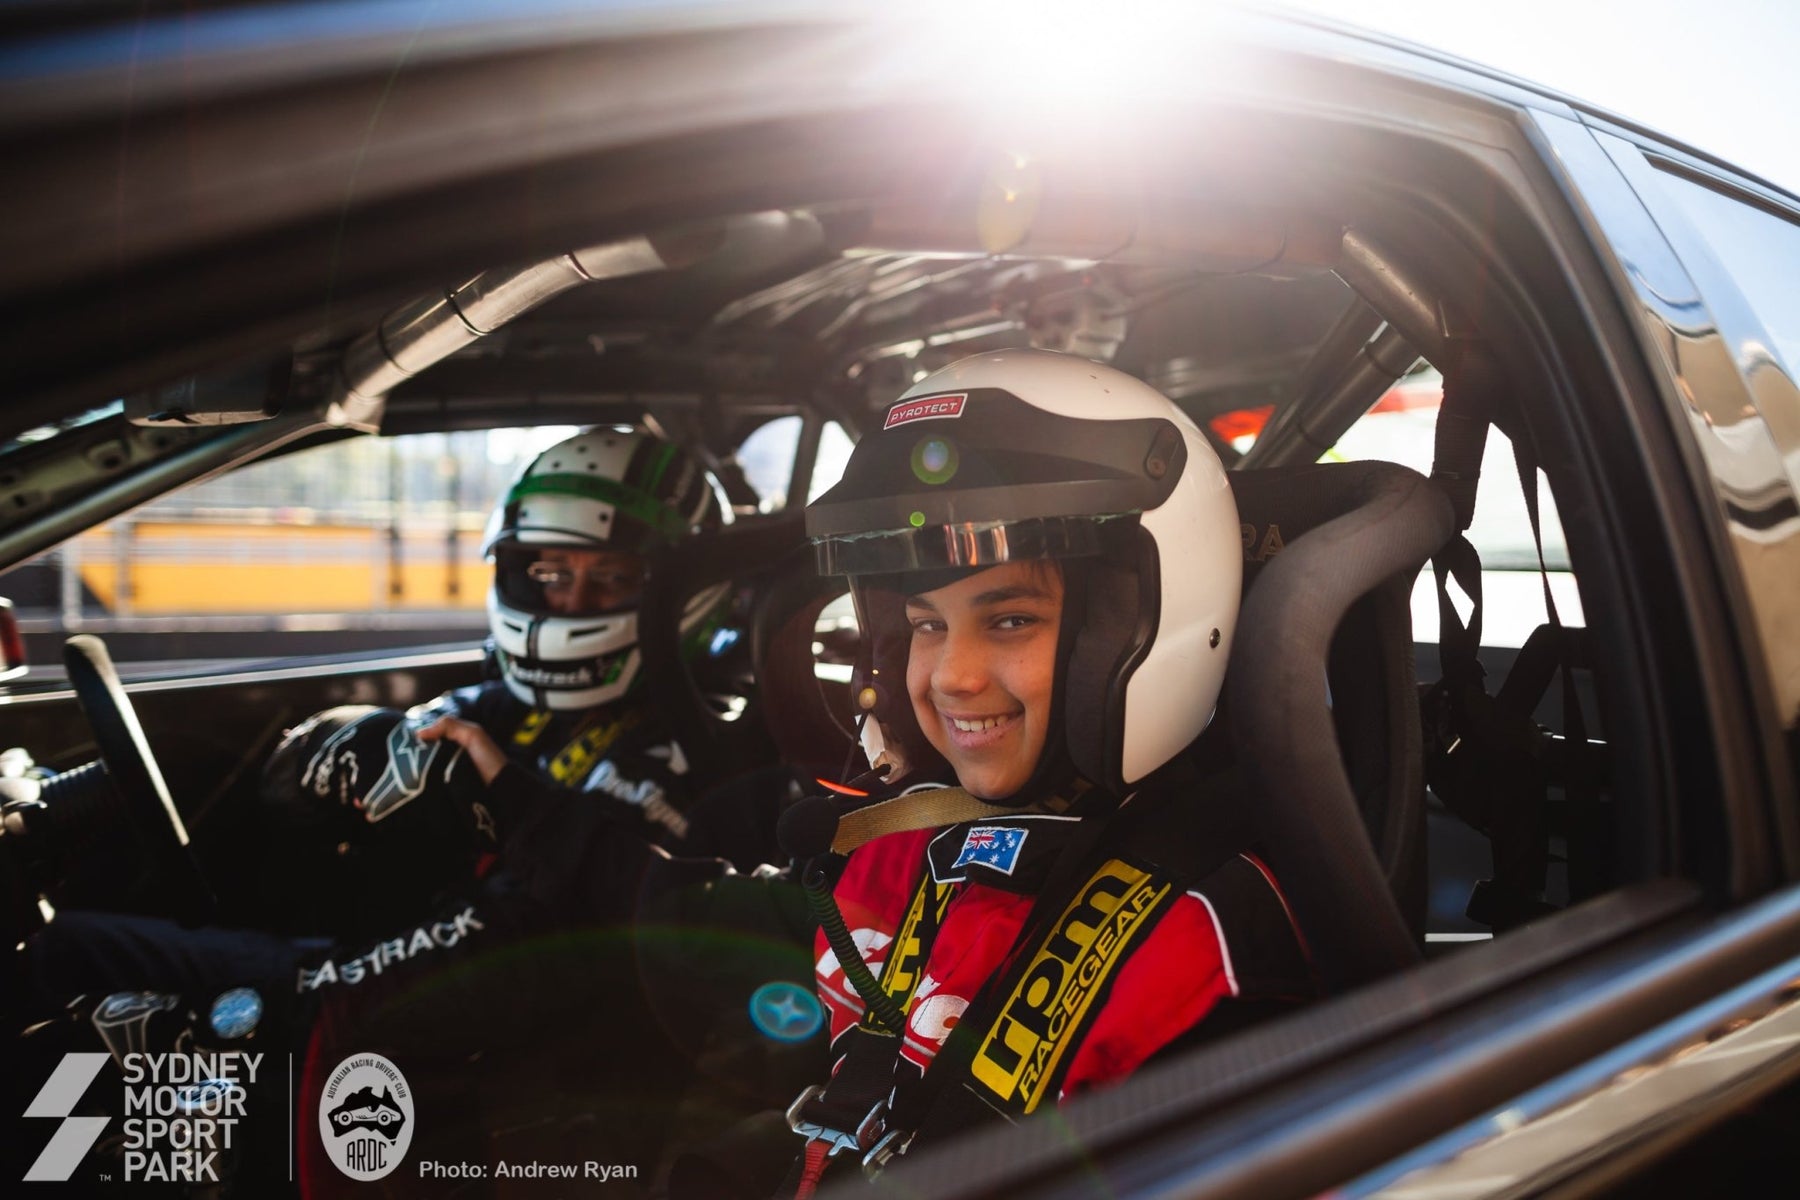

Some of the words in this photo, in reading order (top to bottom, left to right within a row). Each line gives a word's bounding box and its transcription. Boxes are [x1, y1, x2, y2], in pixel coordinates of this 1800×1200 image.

[890, 402, 958, 422] PYROTECT
[295, 905, 485, 994] FASTRACK
[983, 871, 1137, 1077] rpm
[1018, 883, 1158, 1104] RACEGEAR
